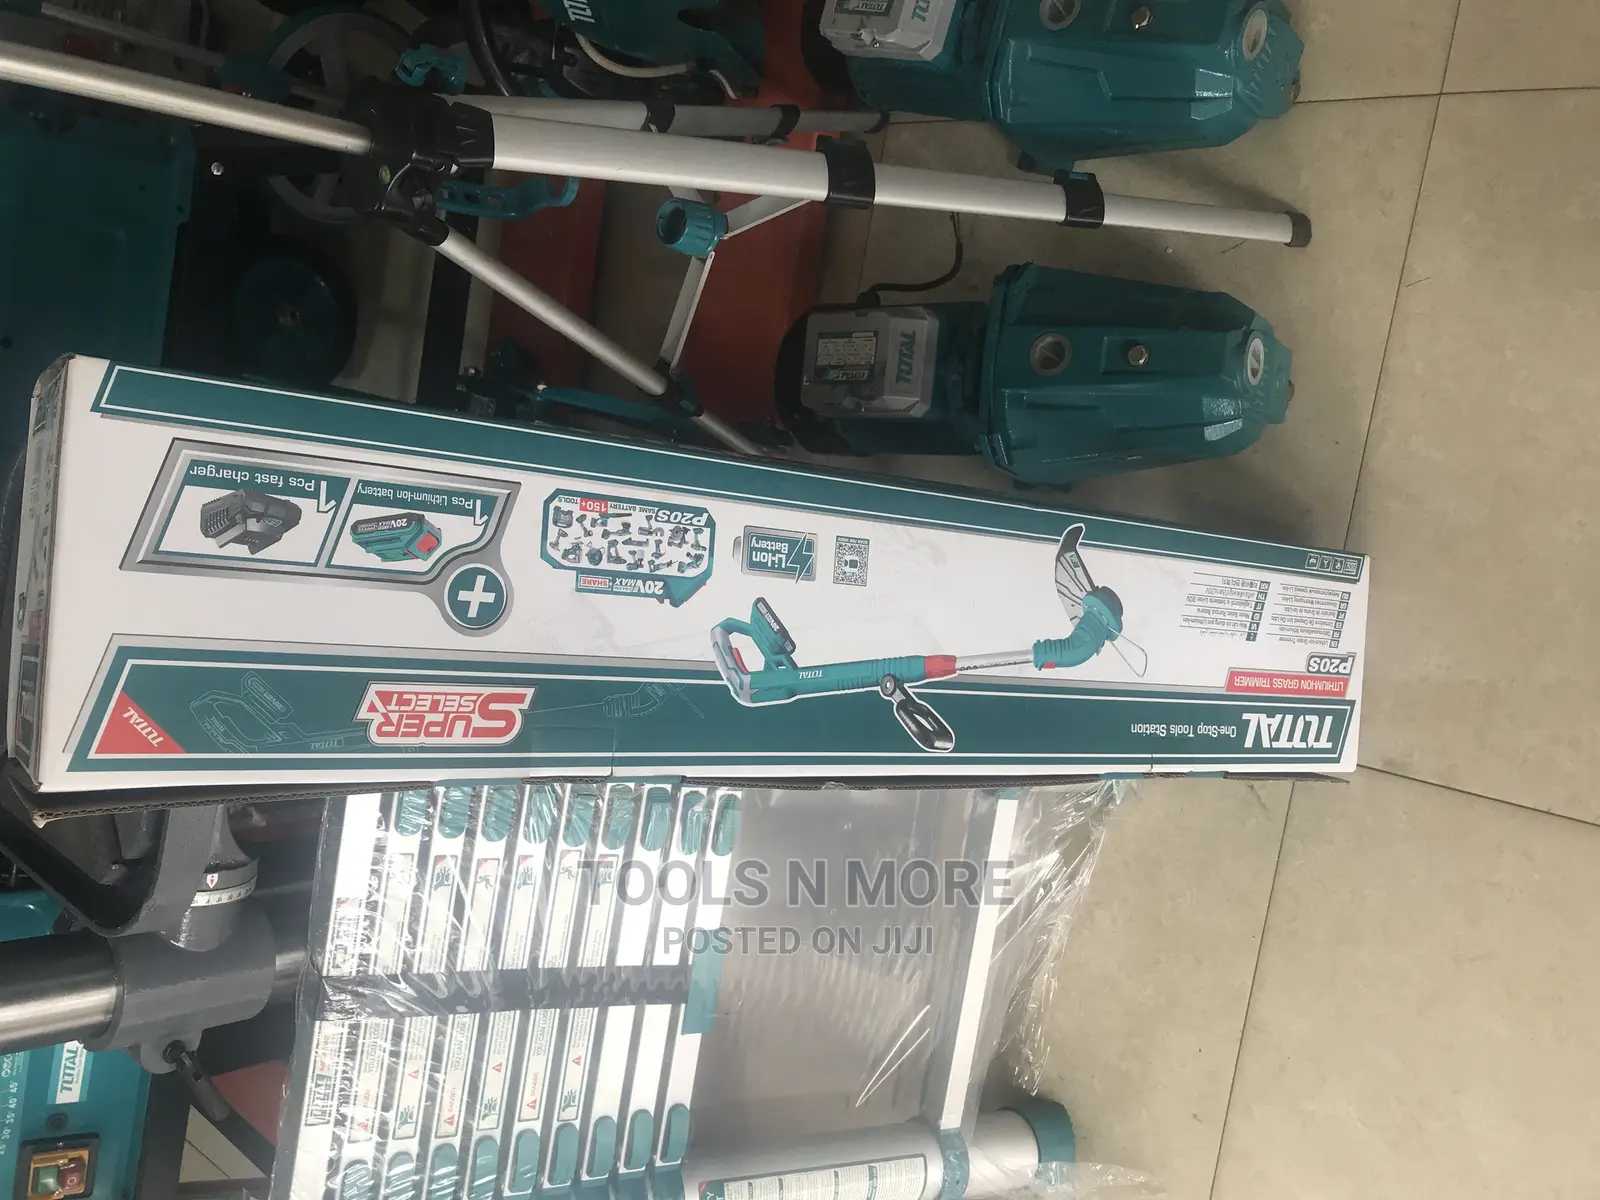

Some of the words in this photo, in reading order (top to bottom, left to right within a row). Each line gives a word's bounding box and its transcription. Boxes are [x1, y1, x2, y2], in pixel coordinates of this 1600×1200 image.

[895, 330, 916, 385] TOTAL
[189, 464, 250, 483] charger
[255, 473, 284, 488] fast
[289, 478, 315, 492] Pcs
[357, 482, 394, 499] battery
[319, 481, 337, 513] 1
[397, 489, 448, 506] Lithium-Ion
[452, 496, 473, 509] Pcs
[558, 496, 578, 504] TOOLS
[476, 499, 489, 525] 1
[580, 500, 607, 512] 150+
[608, 502, 635, 512] BATTERY
[636, 505, 656, 514] SAME
[390, 518, 408, 528] 20V
[656, 510, 709, 525] P20S
[750, 536, 789, 553] Battery
[752, 551, 786, 568] Li-Ion
[581, 578, 608, 586] SHARE
[614, 577, 638, 587] MAX
[636, 579, 664, 595] 20V
[1308, 656, 1353, 674] P20S
[799, 670, 824, 679] TOTAL
[1234, 675, 1271, 687] TRIMMER
[1272, 678, 1299, 690] GRASS
[1300, 680, 1344, 692] LITHIUM-ION
[385, 693, 480, 713] SELECT
[375, 692, 528, 738] SUPER
[122, 706, 165, 747] TOTAL
[1130, 723, 1167, 737] Station
[1170, 724, 1195, 737] Tools
[1197, 722, 1237, 738] One-Stop
[1242, 712, 1333, 749] TOTAL
[60, 1046, 79, 1094] TOTAL
